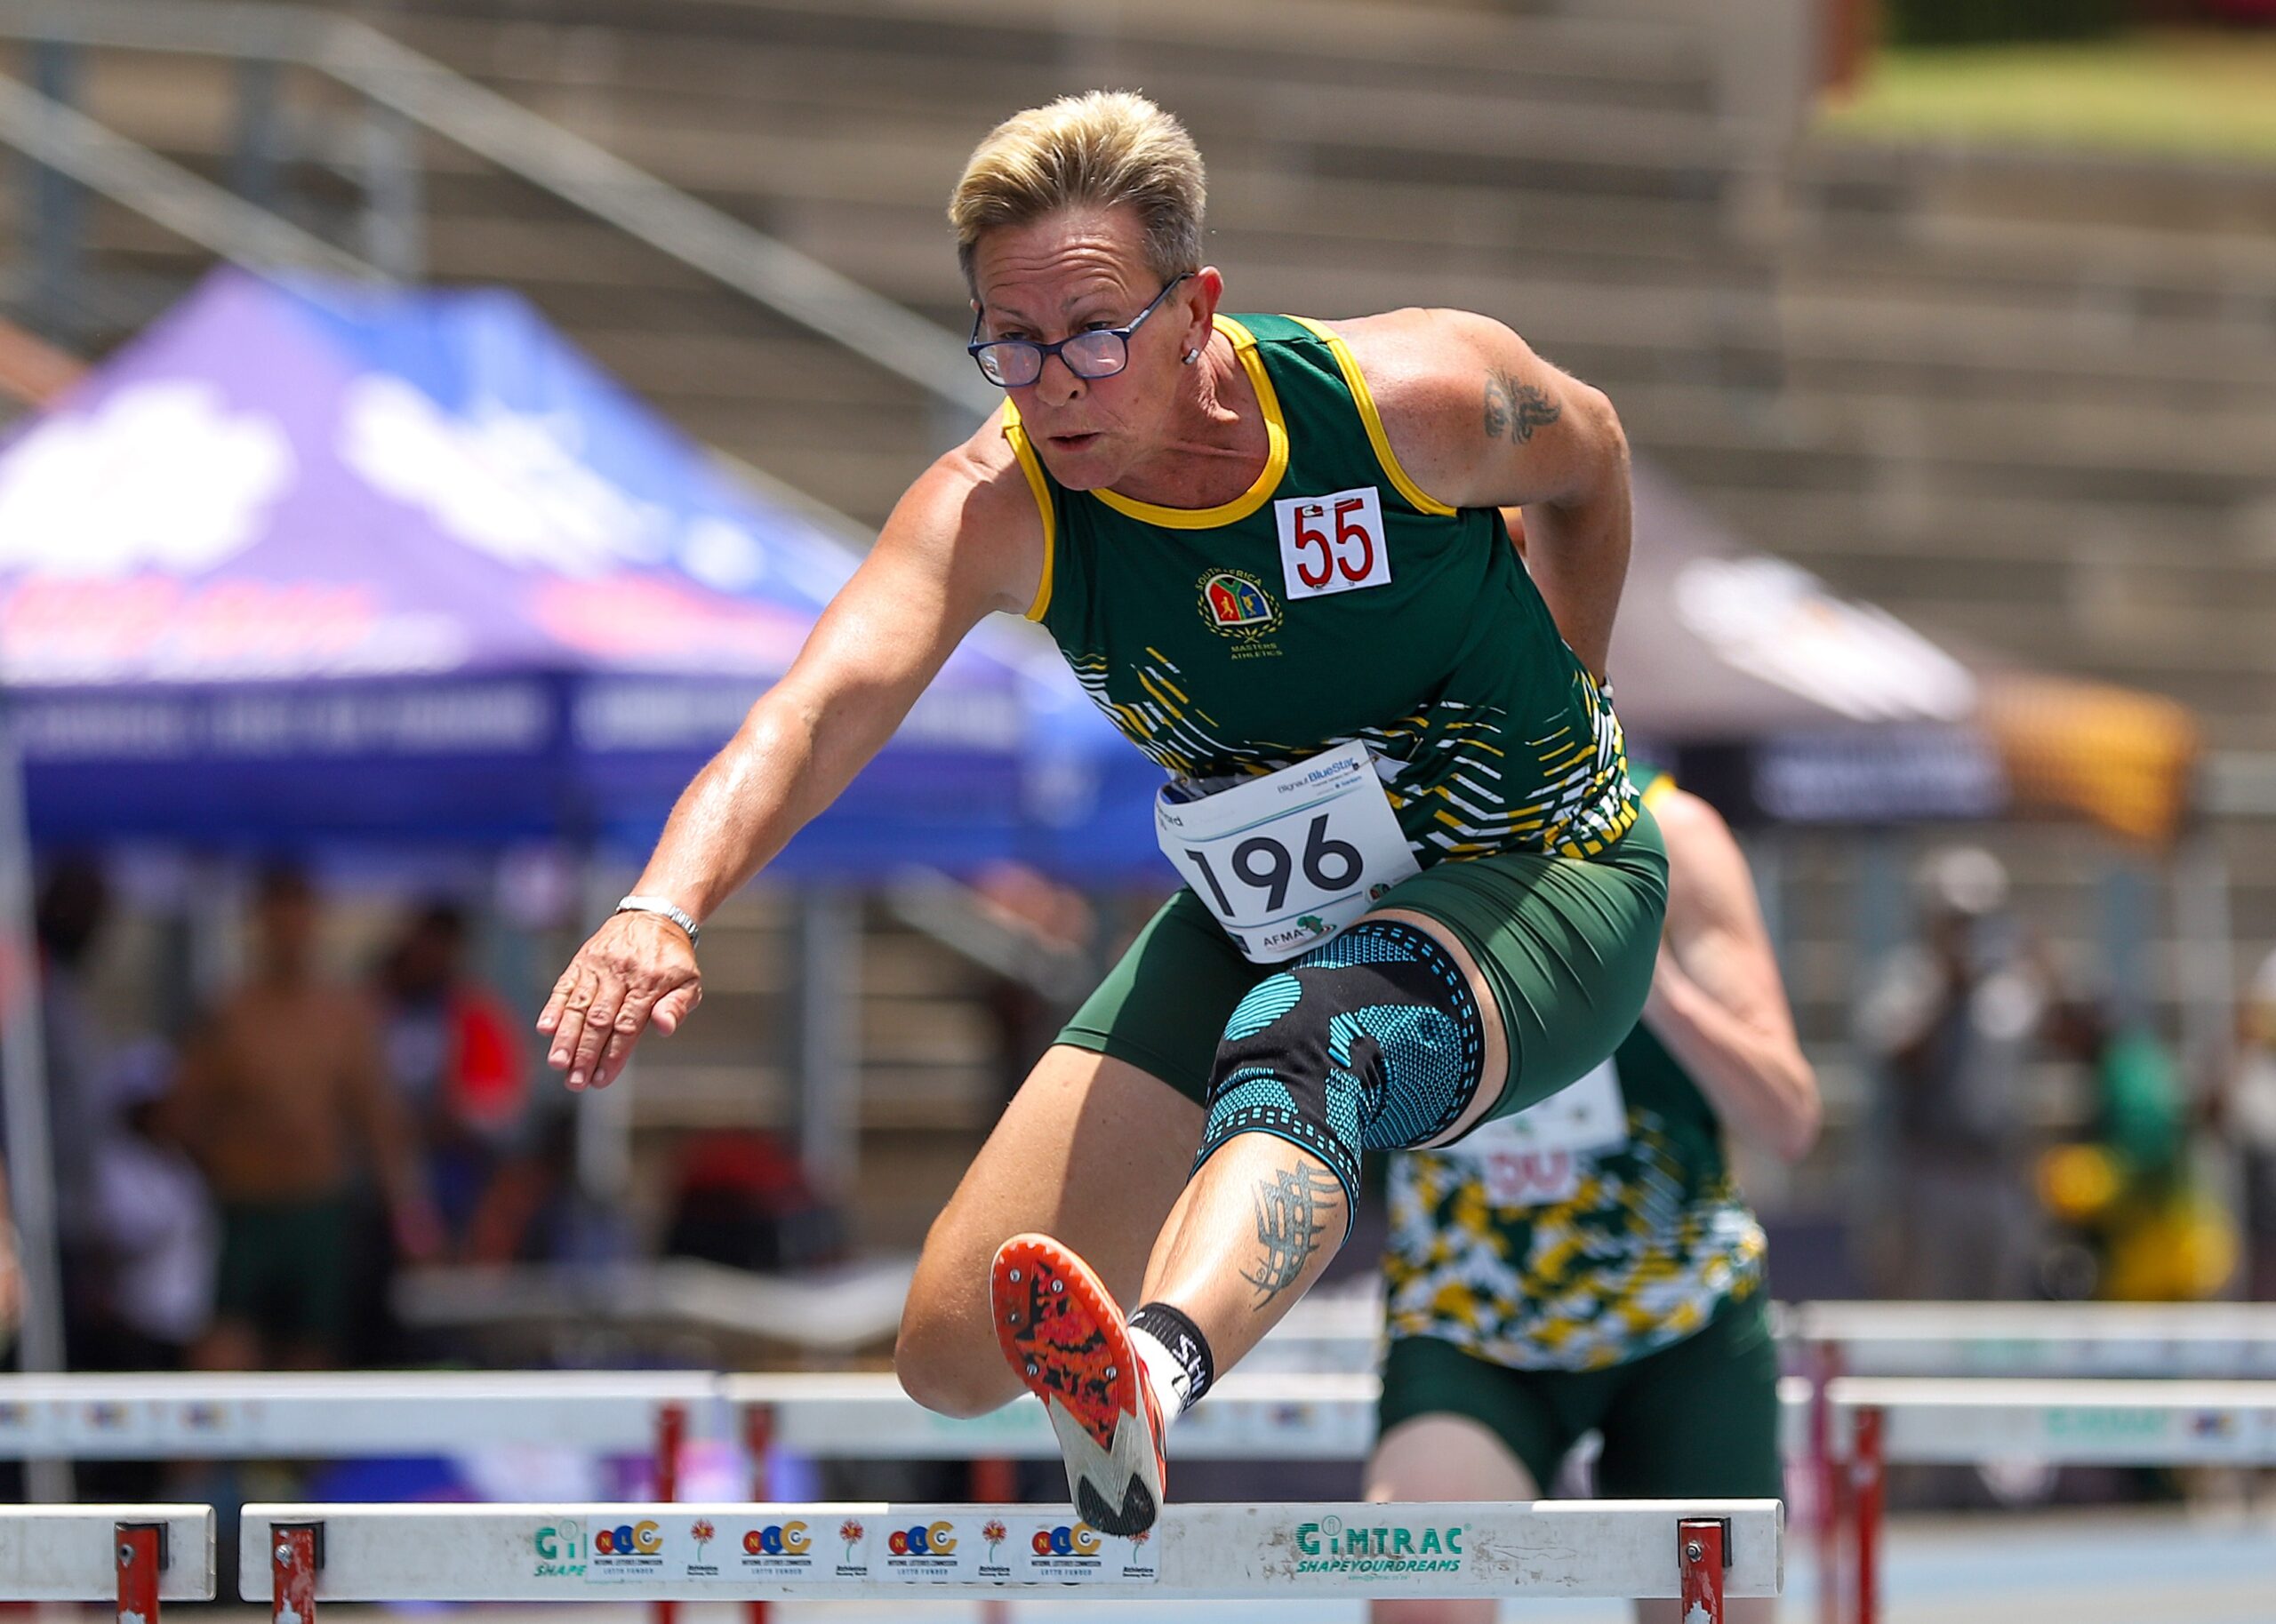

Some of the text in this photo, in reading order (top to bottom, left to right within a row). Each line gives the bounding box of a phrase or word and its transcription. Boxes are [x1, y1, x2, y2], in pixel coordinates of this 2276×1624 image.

[1294, 498, 1374, 588] 55
[1308, 757, 1355, 782] BlueStar
[1185, 813, 1364, 918] 196
[1263, 929, 1303, 947] AFMA
[1297, 1559, 1461, 1572] SHAPEYOURDREAMS
